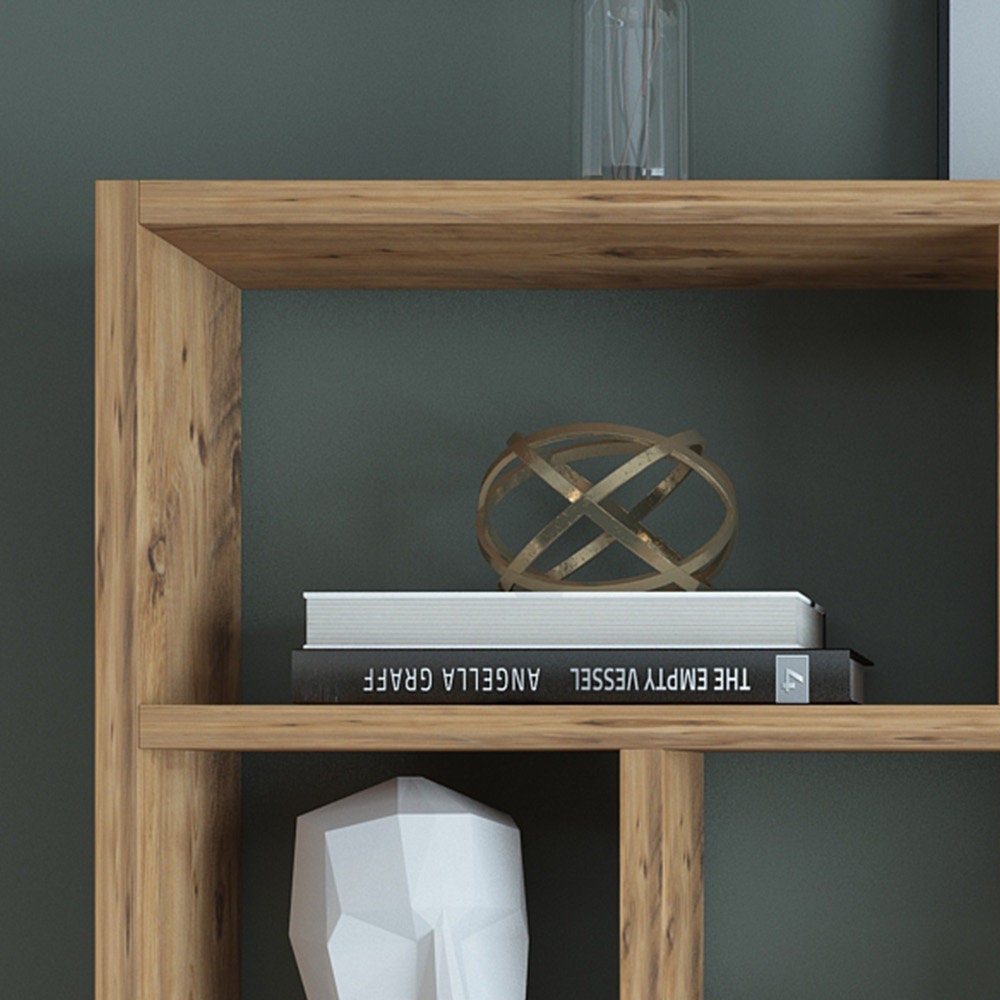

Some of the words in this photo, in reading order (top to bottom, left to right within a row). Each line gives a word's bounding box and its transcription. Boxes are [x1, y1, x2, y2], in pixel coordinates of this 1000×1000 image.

[363, 667, 432, 692] GRAFF
[442, 667, 540, 692] ANGELLA
[570, 667, 639, 691] VESSEL
[644, 667, 707, 691] EMPTY
[714, 667, 750, 691] THE
